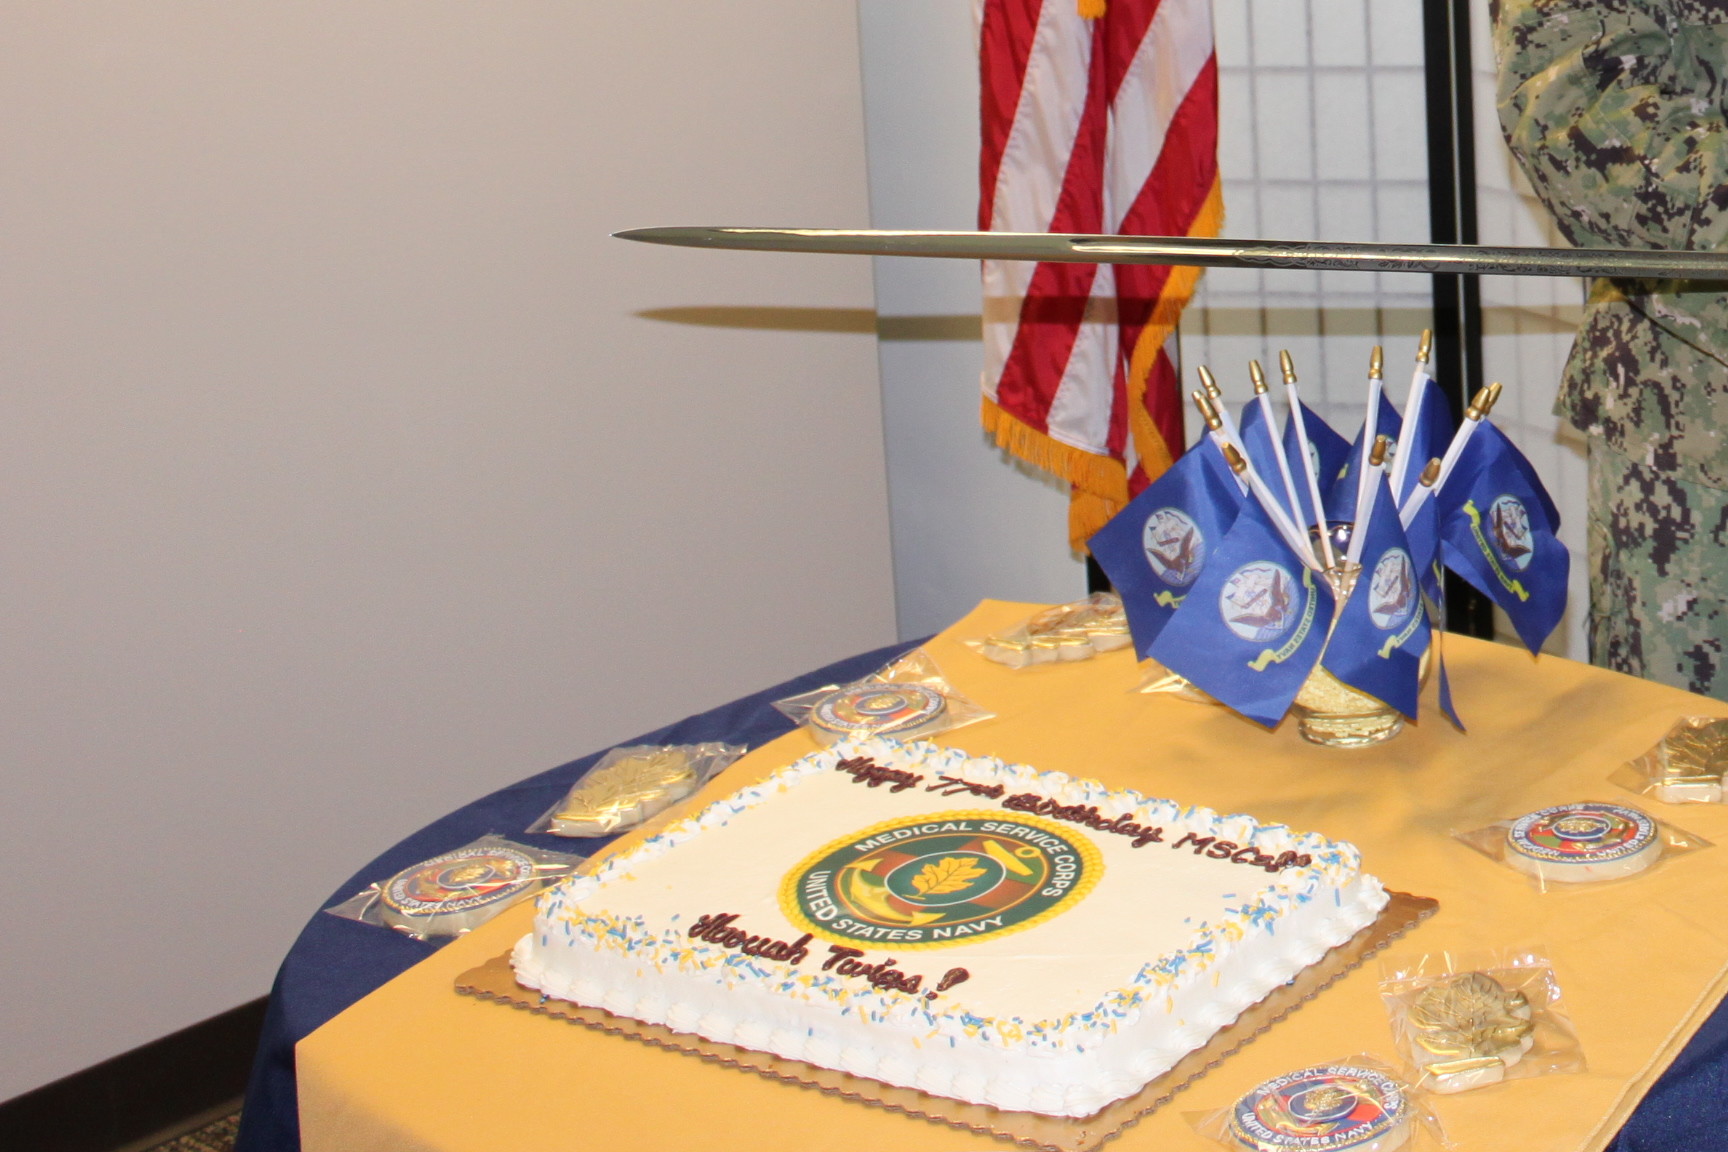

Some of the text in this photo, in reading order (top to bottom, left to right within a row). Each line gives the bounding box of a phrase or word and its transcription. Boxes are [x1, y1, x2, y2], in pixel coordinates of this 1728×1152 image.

[854, 821, 1076, 899] MEDICAL SERVICE CORPS
[806, 870, 1005, 940] UNITED STATES NAVY
[1256, 1068, 1325, 1097] MEDICAL
[1241, 1112, 1374, 1146] UNITED STATES NAVY
